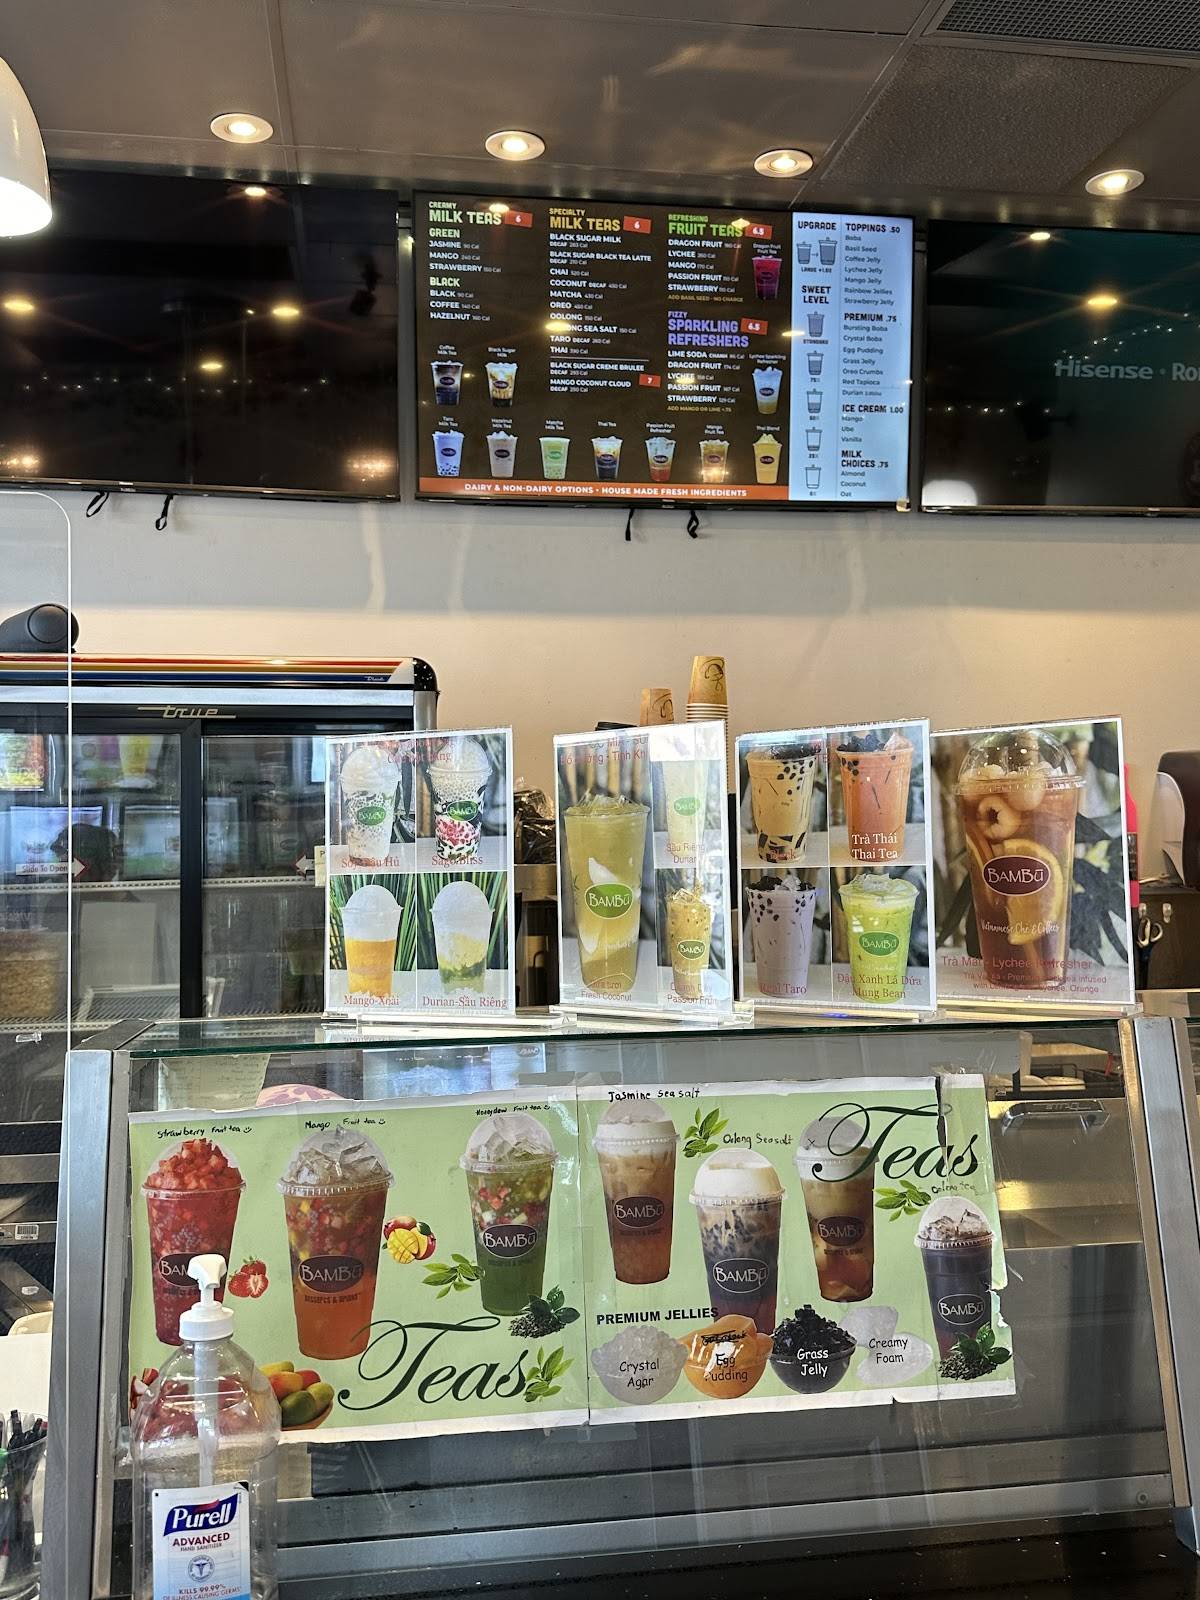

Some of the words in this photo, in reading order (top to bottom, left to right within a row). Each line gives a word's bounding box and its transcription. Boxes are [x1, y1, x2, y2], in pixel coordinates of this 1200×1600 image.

[429, 201, 456, 209] CREAMY
[549, 208, 585, 216] SPECIALTY
[429, 210, 463, 223] MILK
[467, 212, 502, 225] TEAS
[550, 217, 582, 229] MILK
[586, 218, 621, 231] TEAS
[798, 221, 837, 230] UPGRADE
[429, 228, 460, 238] GREEN
[669, 222, 706, 236] FRUIT
[710, 224, 743, 237] TEAS
[550, 233, 575, 241] BLACK
[668, 239, 700, 247] DRAGON
[429, 252, 459, 260] MANGO
[668, 250, 696, 258] LYCHEE
[430, 263, 482, 272] STRAWBERRY
[668, 261, 696, 269] MANGO
[845, 266, 867, 274] Lychee
[430, 277, 460, 287] BLACK
[668, 273, 700, 281] PASSION
[668, 284, 718, 293] STRAWBERRY
[801, 286, 831, 294] SWEET
[430, 301, 460, 309] COFFEE
[803, 296, 829, 304] LEVEL
[844, 298, 879, 306] Strawberry
[430, 312, 471, 320] HAZELNUT
[844, 313, 883, 321] PREMIUM
[668, 319, 738, 333] SPARKLING
[844, 324, 870, 332] Bursting
[668, 333, 749, 347] REFRESHERS
[843, 335, 865, 343] Crystal
[668, 361, 699, 369] DRAGON
[1055, 360, 1153, 379] Hisense
[1172, 362, 1200, 381] Ro
[700, 384, 721, 392] FRUIT
[842, 405, 855, 413] ICE
[858, 405, 887, 413] CREAM
[890, 406, 904, 414] 1.00
[841, 460, 875, 468] CHOICES
[465, 483, 492, 491] DAIRY
[503, 484, 552, 493] NON-DAIRY
[555, 486, 593, 494] OPTIONS
[661, 488, 688, 496] FRESH
[690, 489, 747, 497] INGREDIENTS
[852, 834, 870, 845] Trà
[873, 833, 897, 844] Thái
[852, 850, 876, 859] Thai
[878, 849, 898, 859] Tea
[22, 865, 38, 873] Slide
[988, 868, 1044, 883] BAMBŪ
[588, 893, 630, 908] BAMBŪ
[859, 974, 883, 984] Xanh
[887, 975, 898, 984] Lá
[784, 984, 807, 995] Taro
[883, 988, 906, 998] Bean
[1070, 985, 1099, 993] Orange
[608, 1091, 651, 1102] Jasmine
[305, 1121, 331, 1131] Mango
[812, 1103, 979, 1183] Teas
[615, 1203, 664, 1218] BAMBŪ
[484, 1233, 536, 1248] BAMBŪ
[301, 1264, 362, 1282] BAMBŪ
[940, 1302, 984, 1316] BAMBŪ
[596, 1311, 661, 1325] PREMIUM
[665, 1307, 719, 1321] JELLIES
[868, 1338, 909, 1350] Creamy
[797, 1349, 829, 1361] Grass
[876, 1353, 904, 1364] Foam
[337, 1316, 529, 1410] Teas
[619, 1359, 659, 1372] Crystal
[716, 1353, 736, 1368] Egg
[800, 1363, 828, 1377] Jelly
[627, 1376, 654, 1390] Agar
[172, 1503, 231, 1529] Purell
[172, 1532, 230, 1547] ADVANCED
[197, 1543, 222, 1551] SANITIZER
